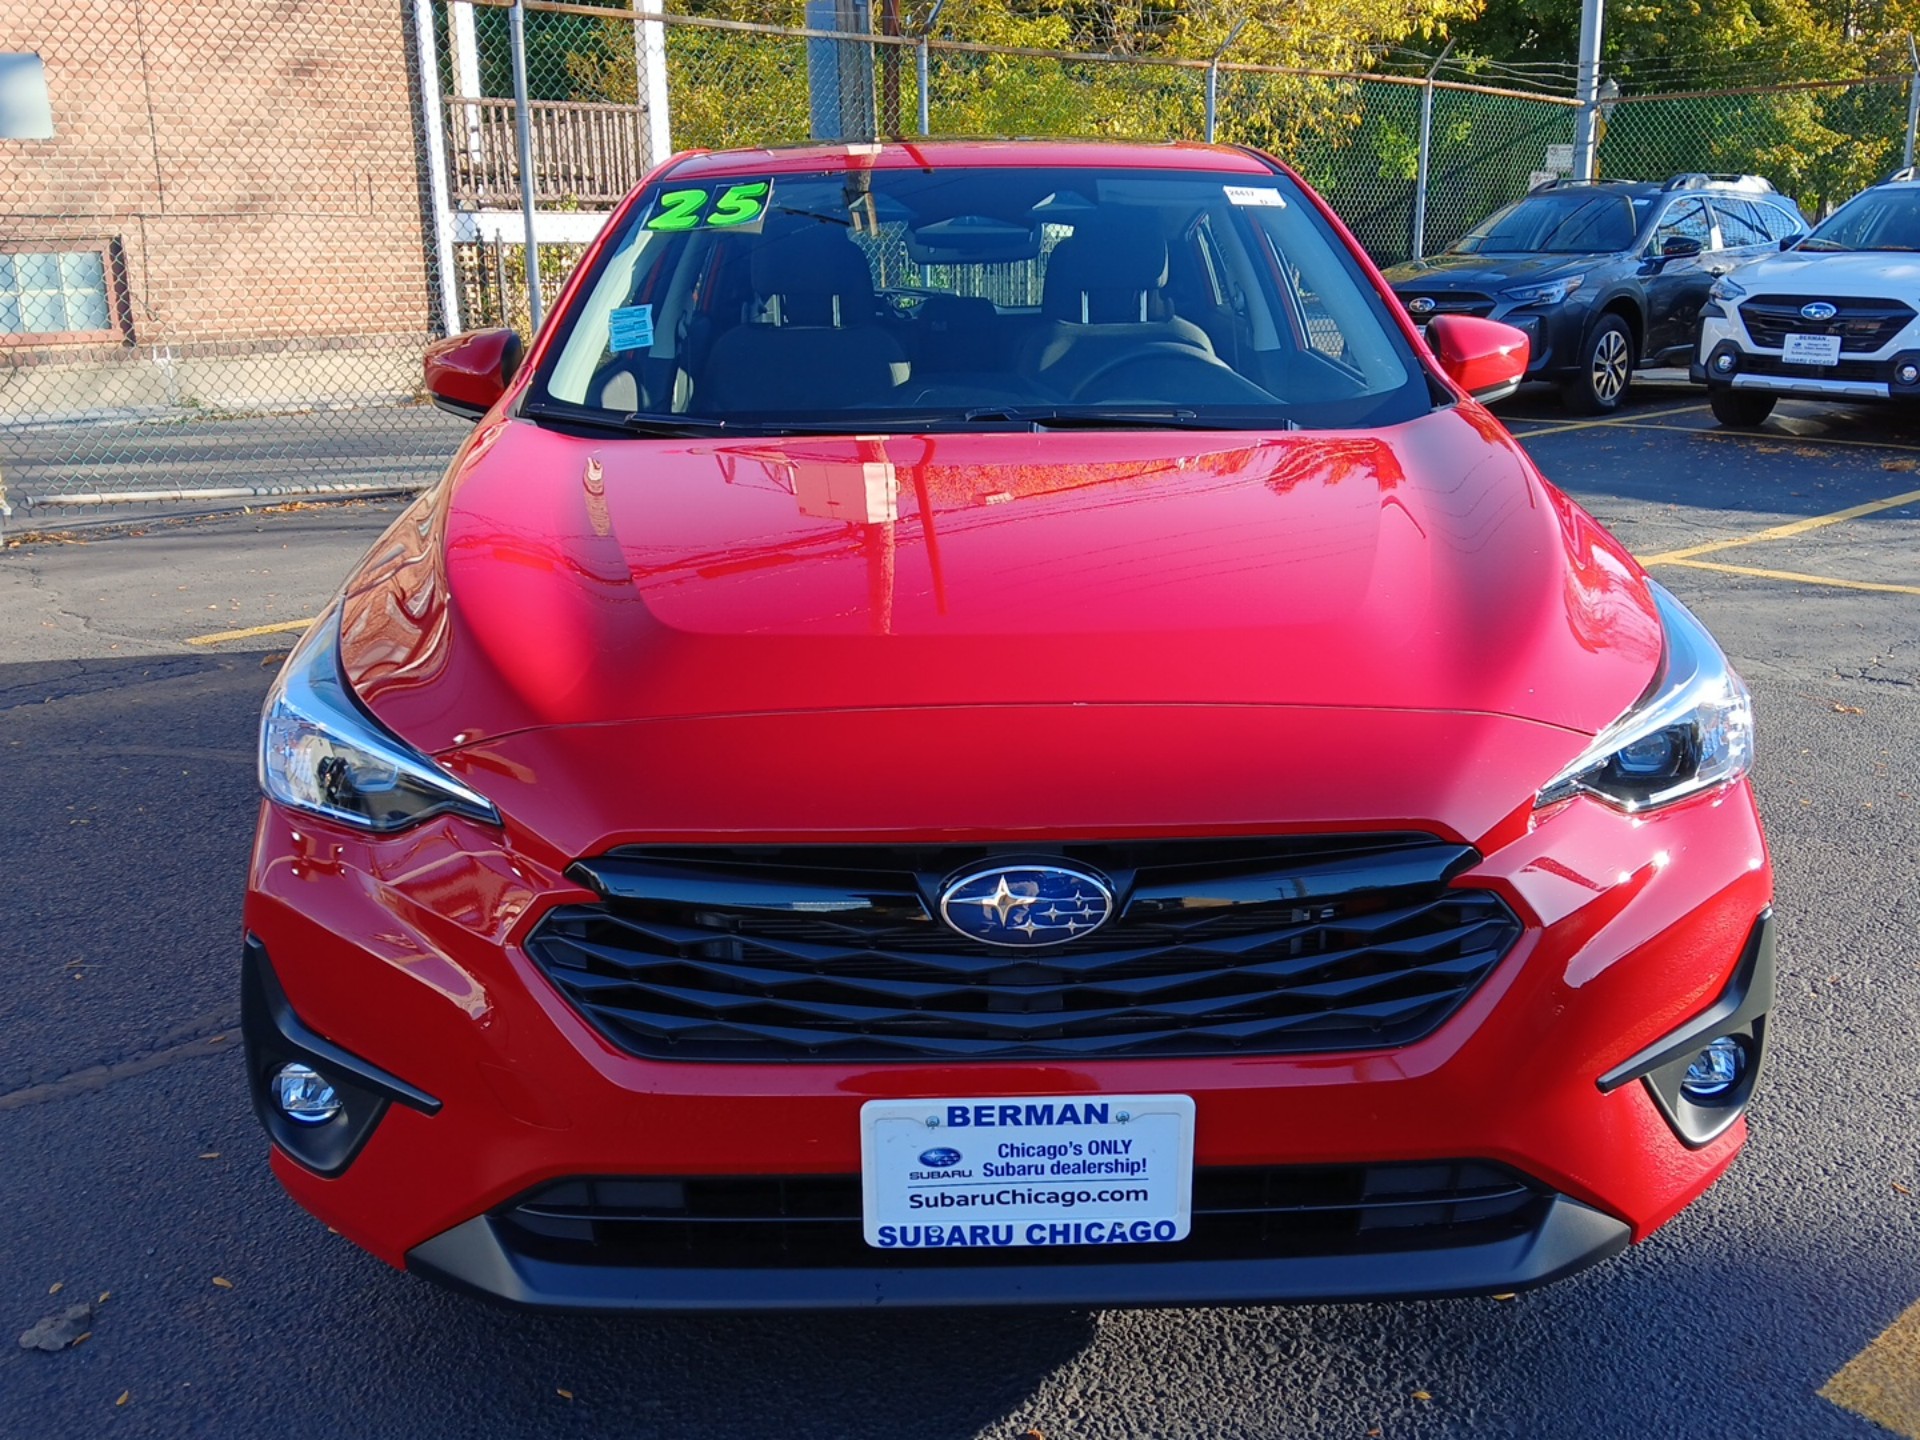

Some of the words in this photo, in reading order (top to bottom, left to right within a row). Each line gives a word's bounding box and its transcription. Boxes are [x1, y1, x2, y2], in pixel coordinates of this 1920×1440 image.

[647, 182, 769, 230] 25
[946, 1103, 1109, 1128] BERMAN
[997, 1141, 1083, 1160] Chicago's
[1087, 1139, 1133, 1156] ONLY
[909, 1169, 973, 1180] SUBARU
[982, 1162, 1045, 1178] Subaru
[1050, 1158, 1147, 1176] dealership!
[908, 1188, 1149, 1209] SubaruChicago.com
[877, 1224, 1014, 1247] SUBARU
[1025, 1220, 1177, 1245] CHICAGO
